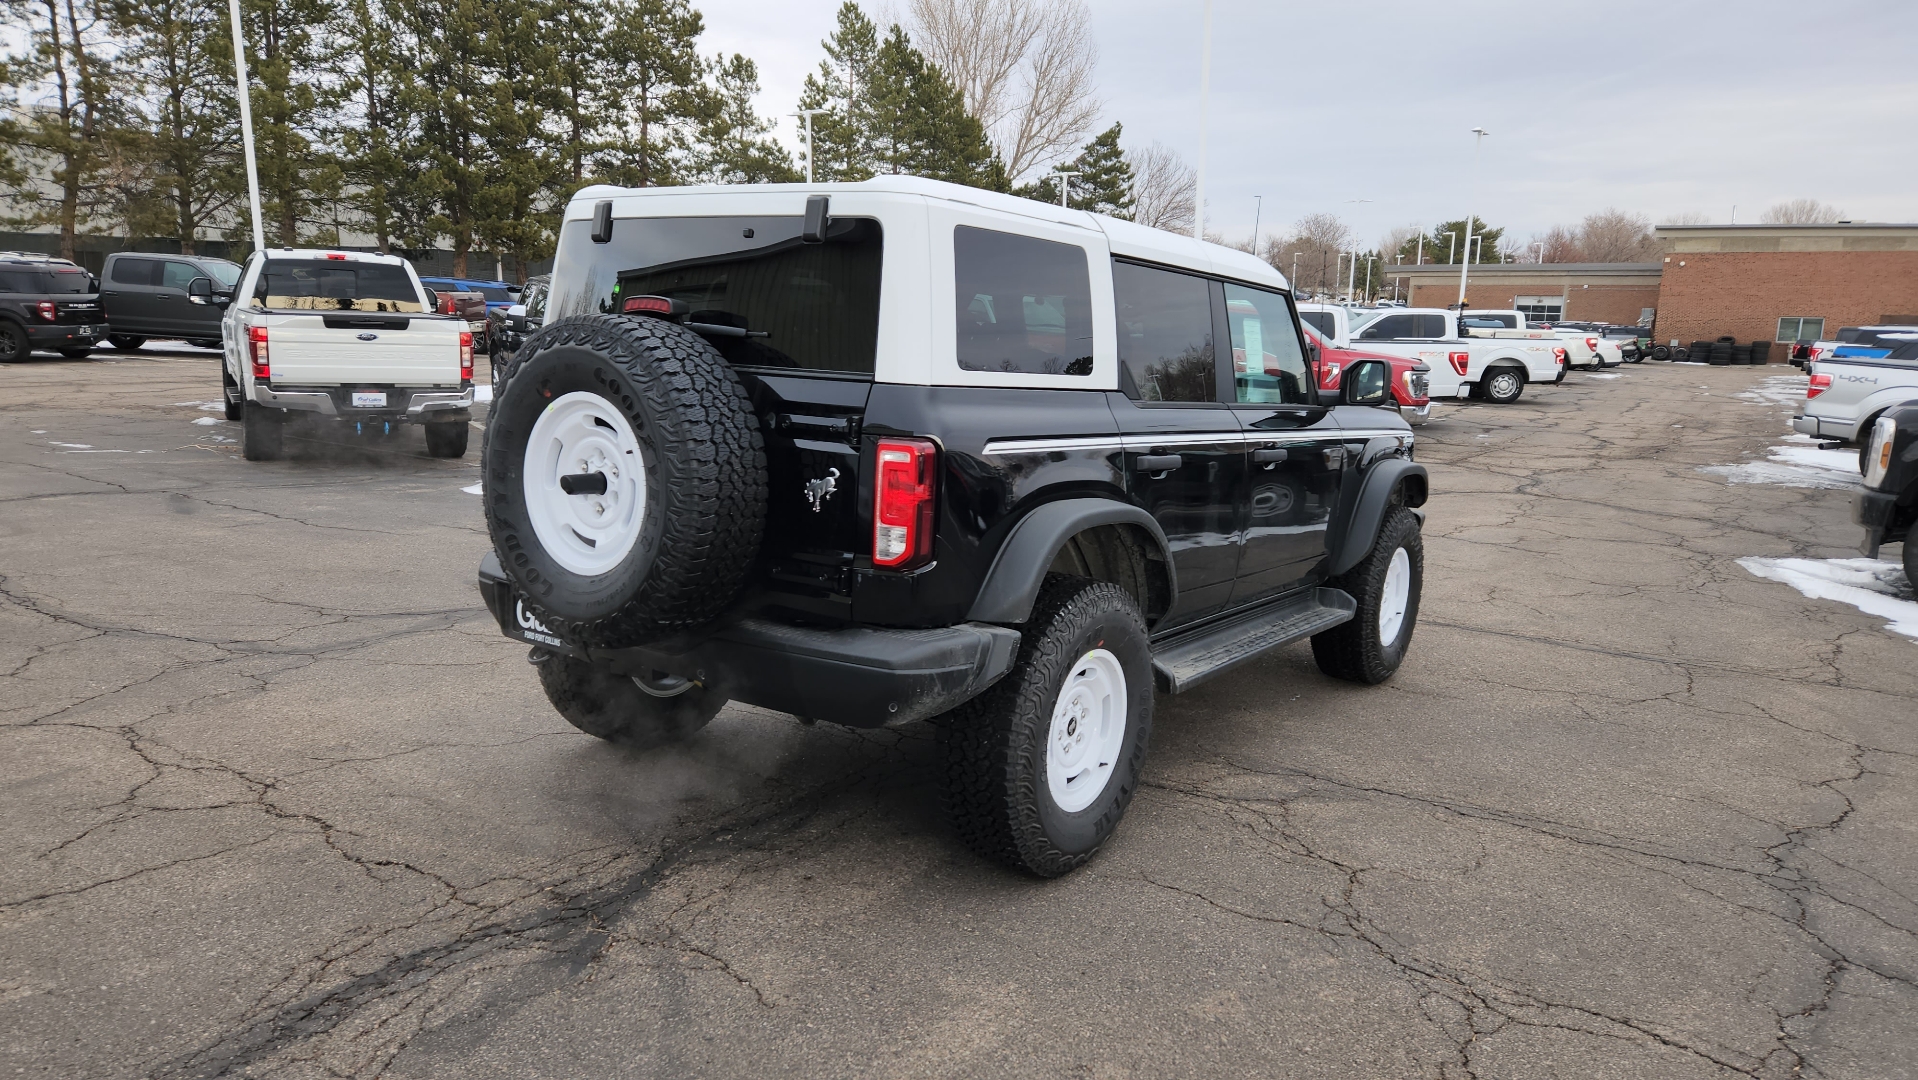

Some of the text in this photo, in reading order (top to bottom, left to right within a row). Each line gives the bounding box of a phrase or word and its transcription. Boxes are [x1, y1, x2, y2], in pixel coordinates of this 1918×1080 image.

[1838, 374, 1879, 385] 4X4
[524, 630, 535, 640] FORD
[545, 635, 560, 647] COLLINS
